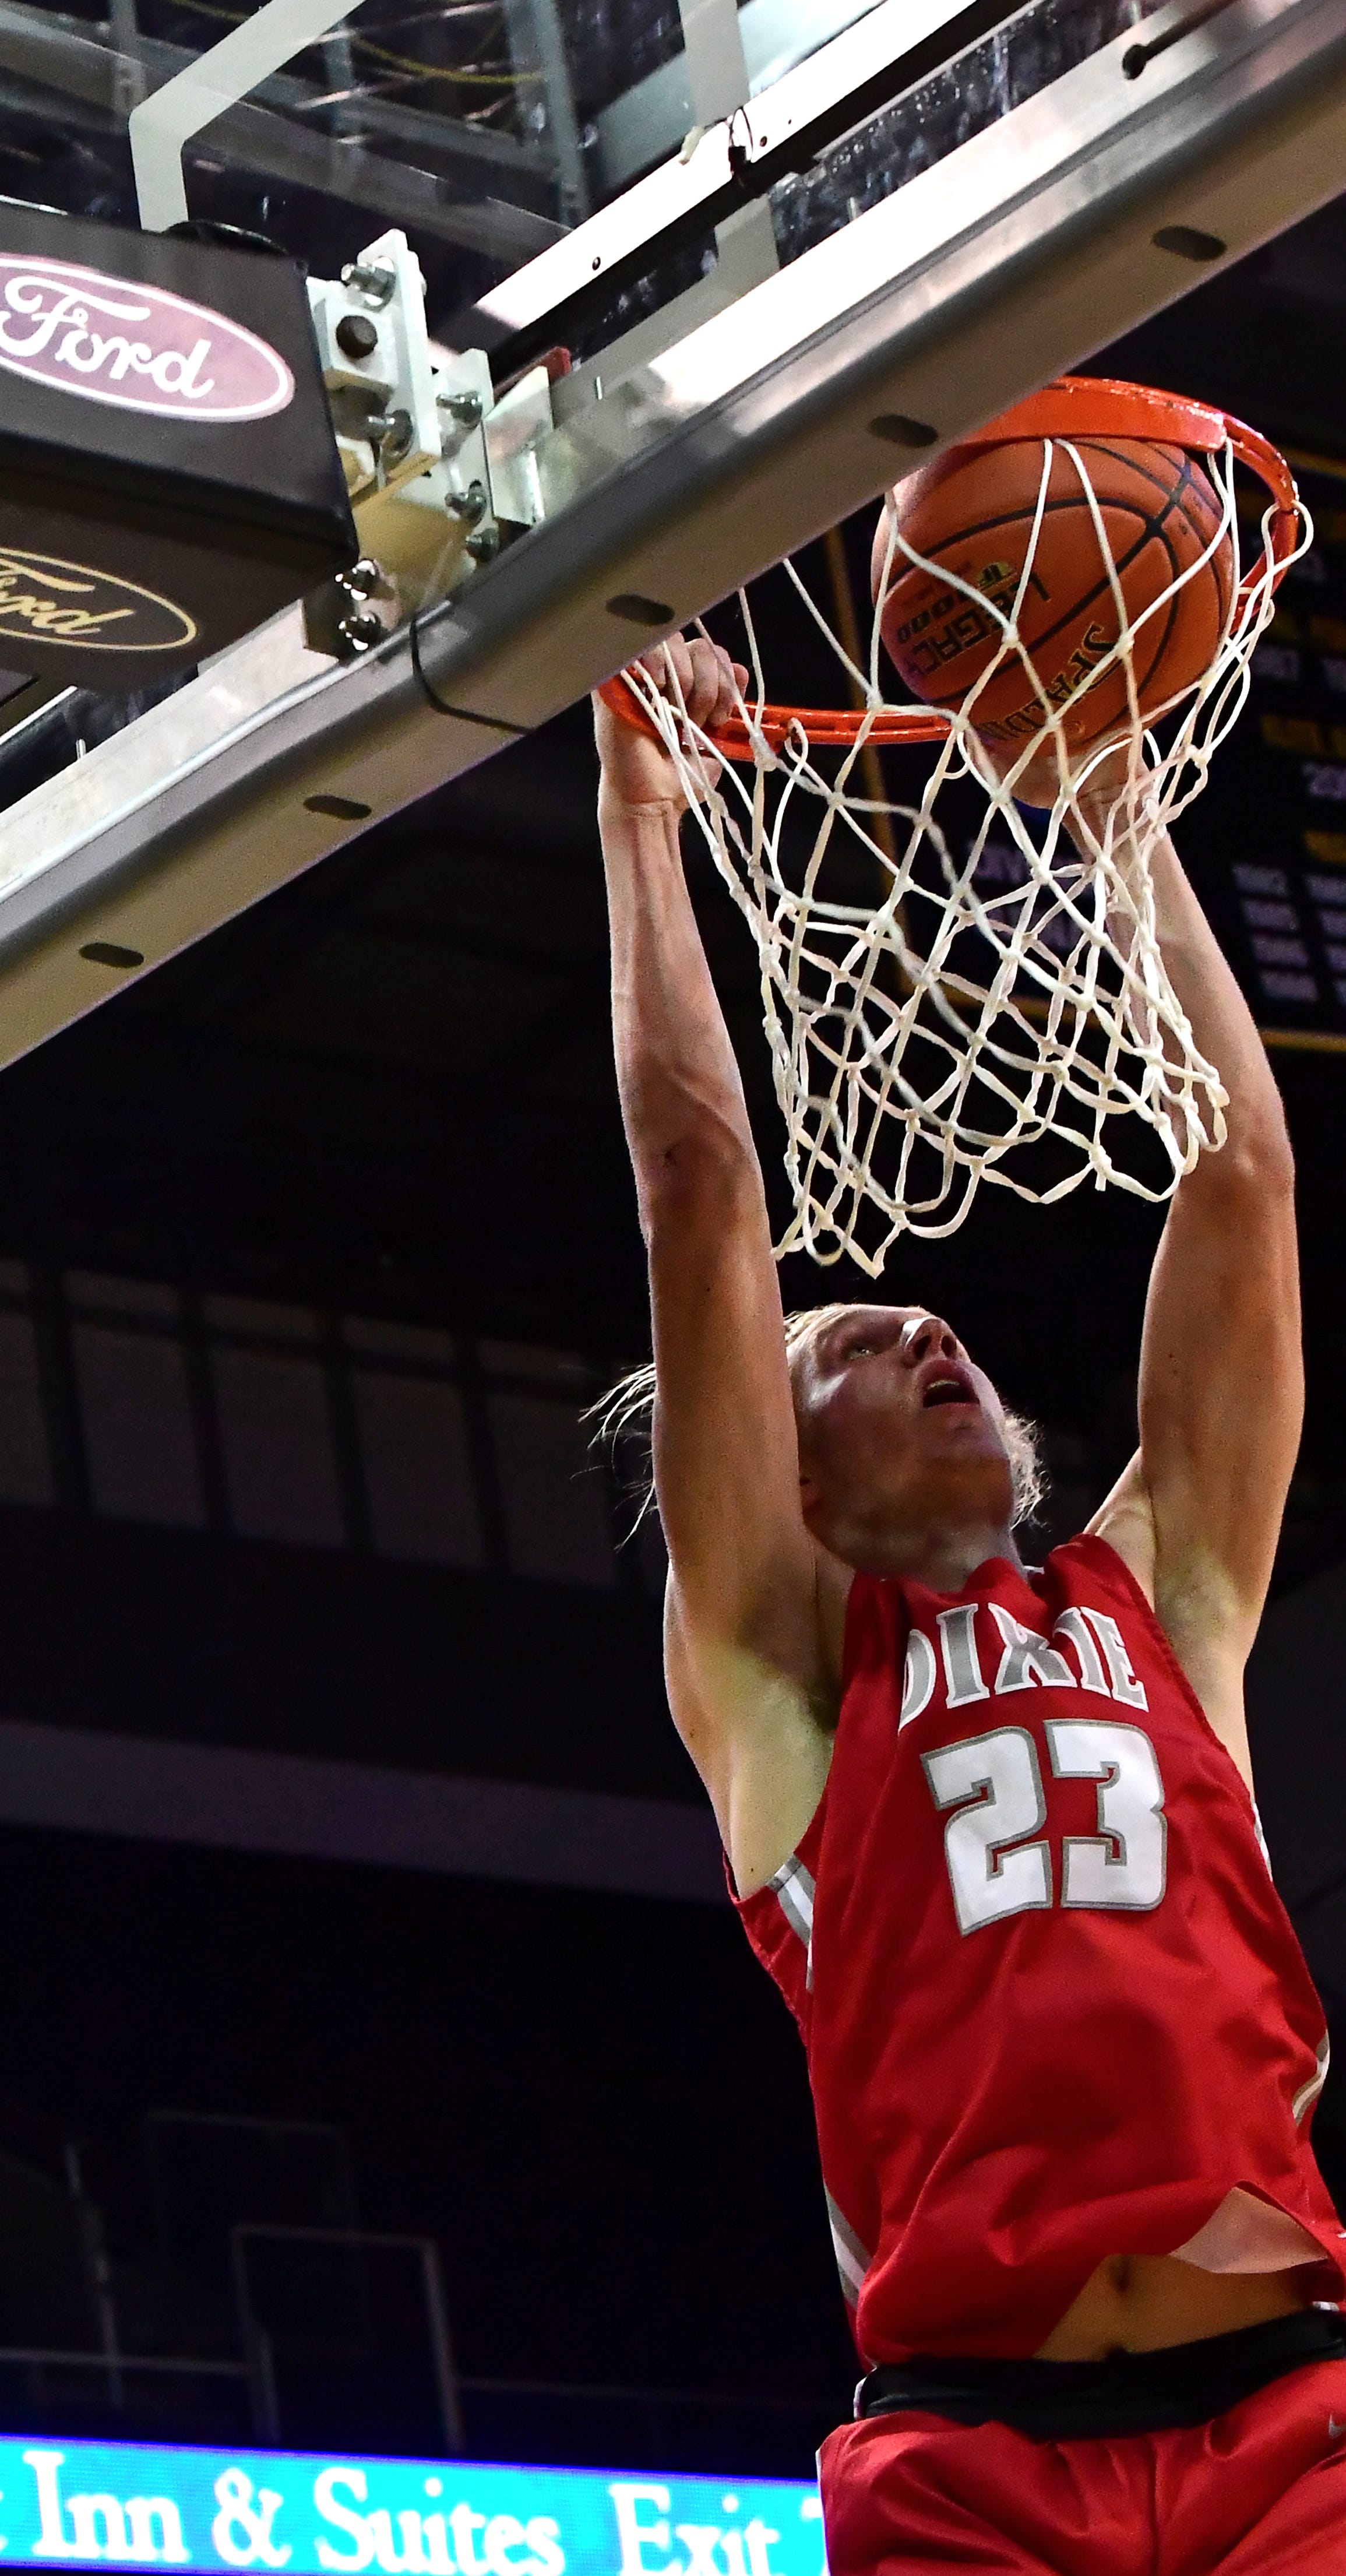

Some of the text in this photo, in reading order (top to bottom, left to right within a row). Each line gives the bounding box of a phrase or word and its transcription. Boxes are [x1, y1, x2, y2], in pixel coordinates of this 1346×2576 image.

[2, 275, 214, 399] Ford
[898, 1602, 1149, 1734] DIXIE
[919, 1718, 1168, 1938] 23
[22, 2450, 191, 2563] Inn
[212, 2466, 291, 2567] &
[313, 2466, 565, 2576] Suites
[608, 2483, 781, 2576] Exit
